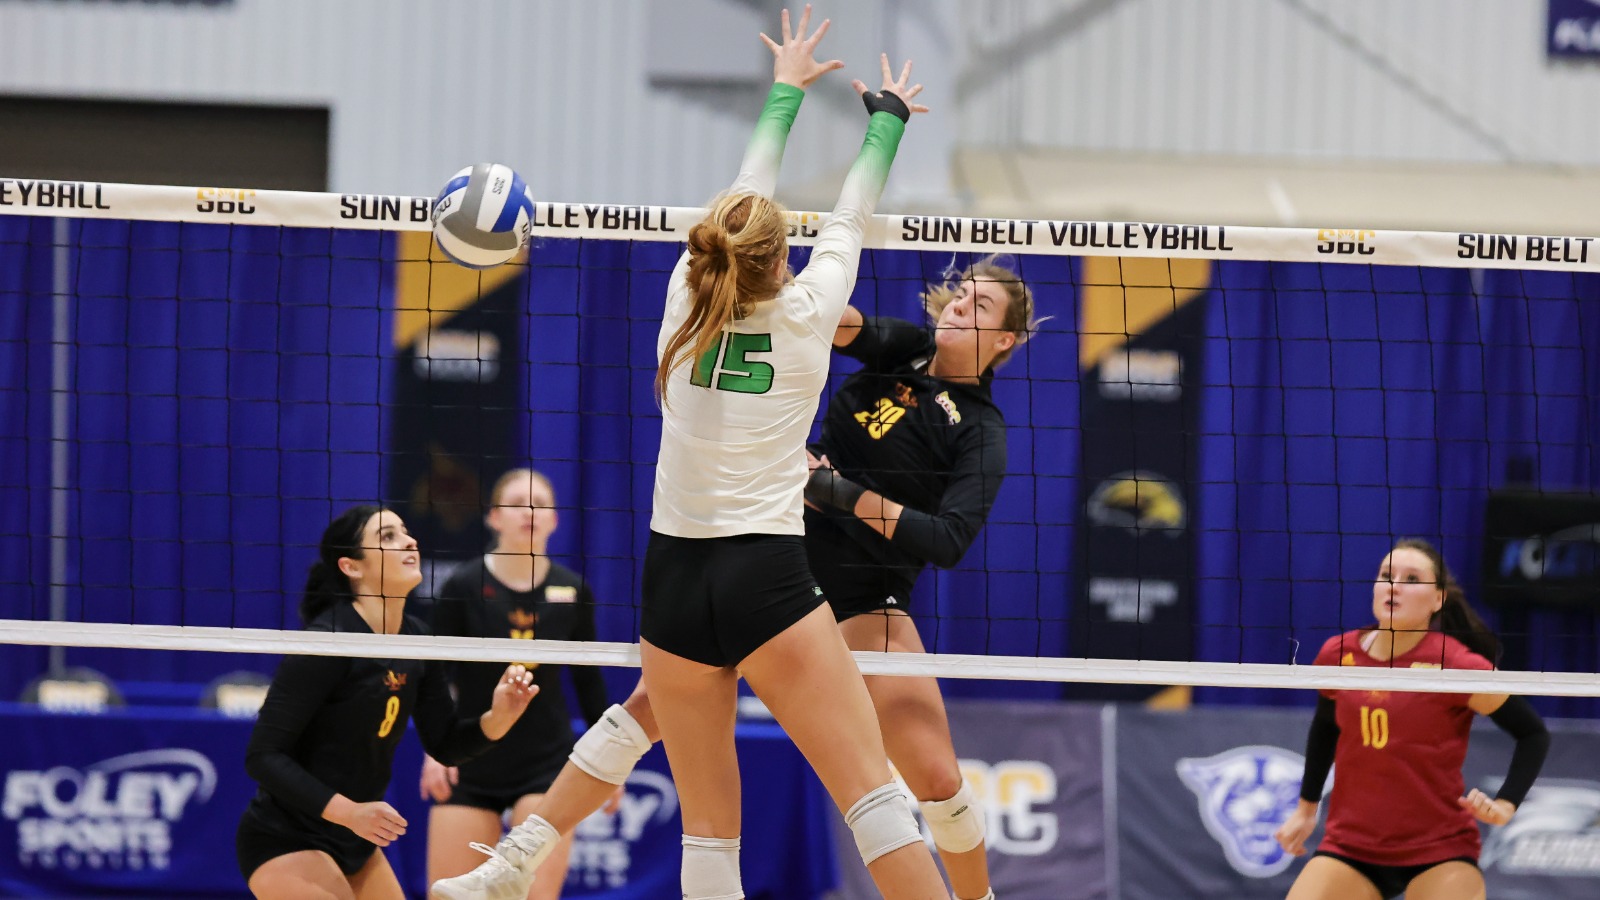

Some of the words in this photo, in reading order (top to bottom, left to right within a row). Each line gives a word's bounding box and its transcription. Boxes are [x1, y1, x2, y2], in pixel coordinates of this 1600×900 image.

[196, 187, 256, 214] SBC
[340, 194, 400, 221] SUN
[902, 216, 961, 243] SUN
[971, 219, 1039, 245] BELT
[1048, 221, 1234, 251] VOLLEYBALL
[1317, 229, 1375, 255] SBC
[1457, 233, 1517, 260] SUN
[1525, 236, 1594, 263] BELT
[690, 331, 775, 394] 15
[377, 695, 400, 738] 8
[1360, 705, 1389, 749] 10
